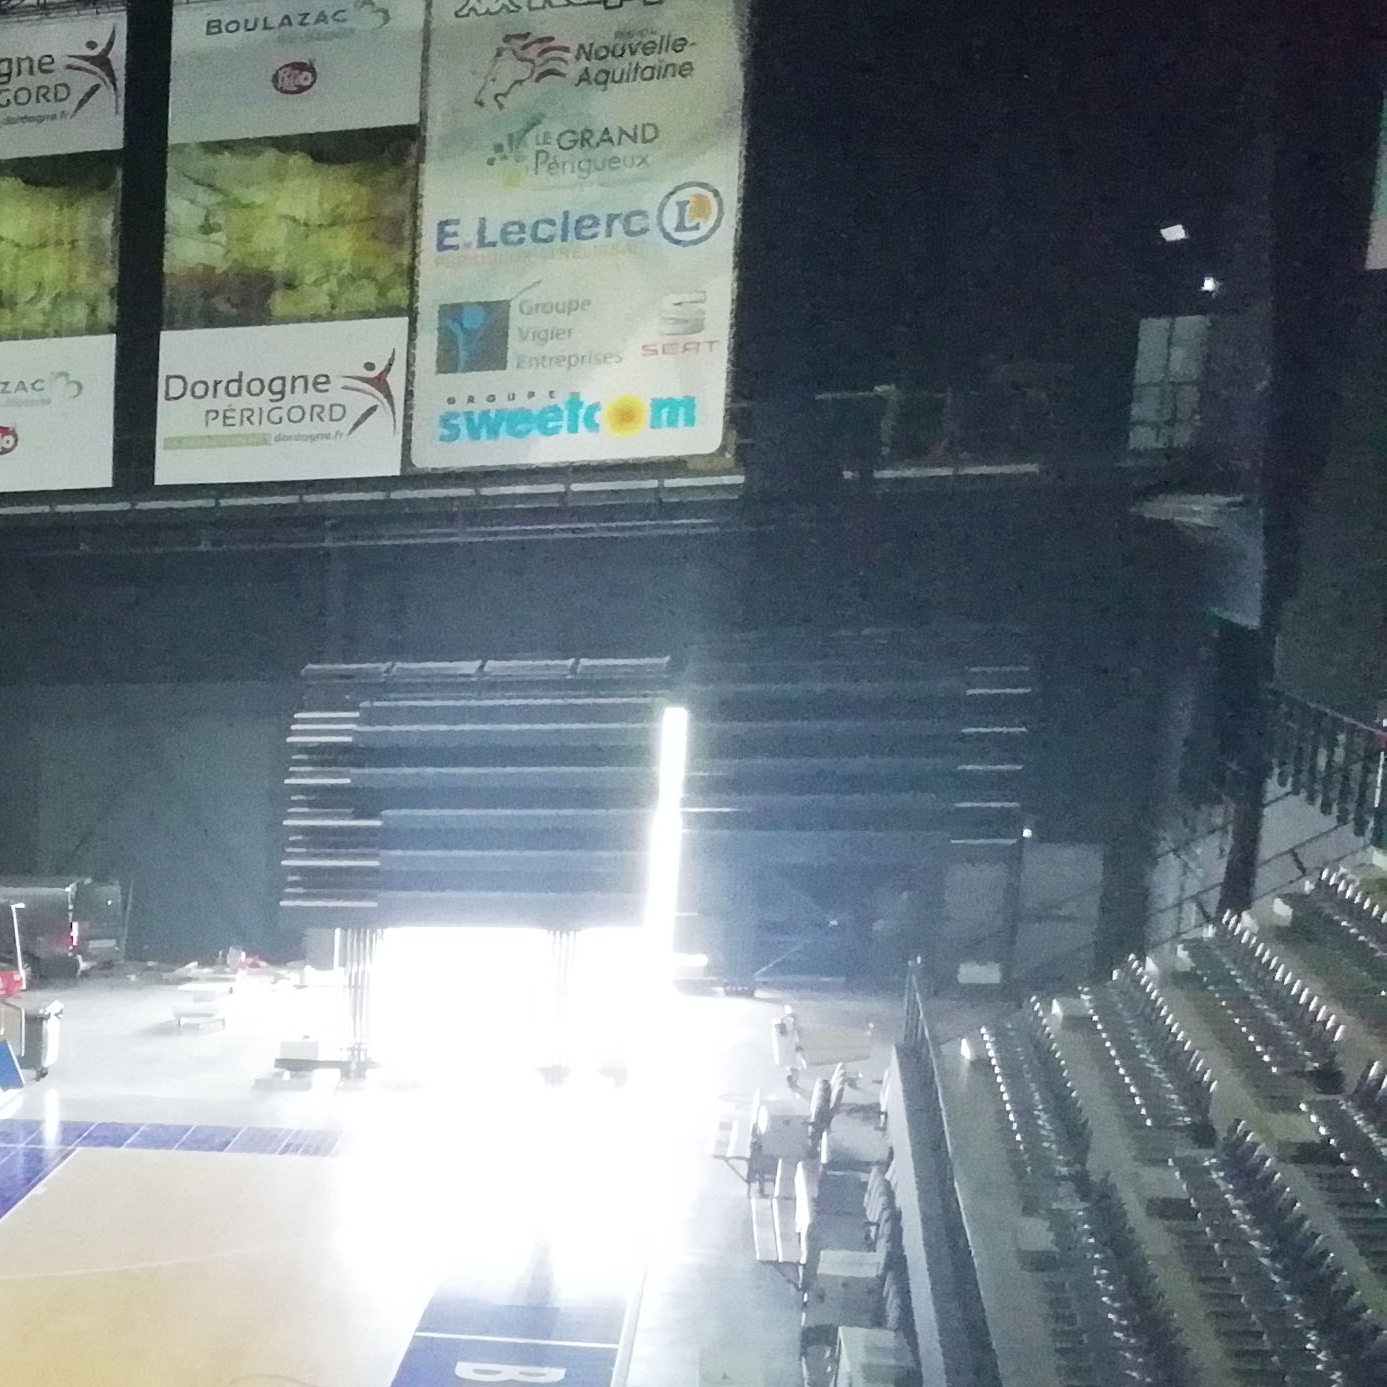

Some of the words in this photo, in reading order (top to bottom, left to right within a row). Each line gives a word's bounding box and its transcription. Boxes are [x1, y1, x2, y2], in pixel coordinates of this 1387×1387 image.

[205, 9, 347, 36] BOULAZAC
[574, 60, 694, 91] Aquitaine
[556, 122, 660, 150] GRAND
[535, 150, 651, 179] Périgueux
[436, 209, 650, 252] E.Leclerc
[519, 298, 593, 317] Groupe
[519, 326, 574, 345] Vigier
[641, 340, 721, 357] SEAT
[516, 352, 624, 374] Entreprises
[164, 371, 332, 403] Dordogne
[447, 390, 557, 405] GROUPE
[204, 403, 347, 427] PÉRIGORD
